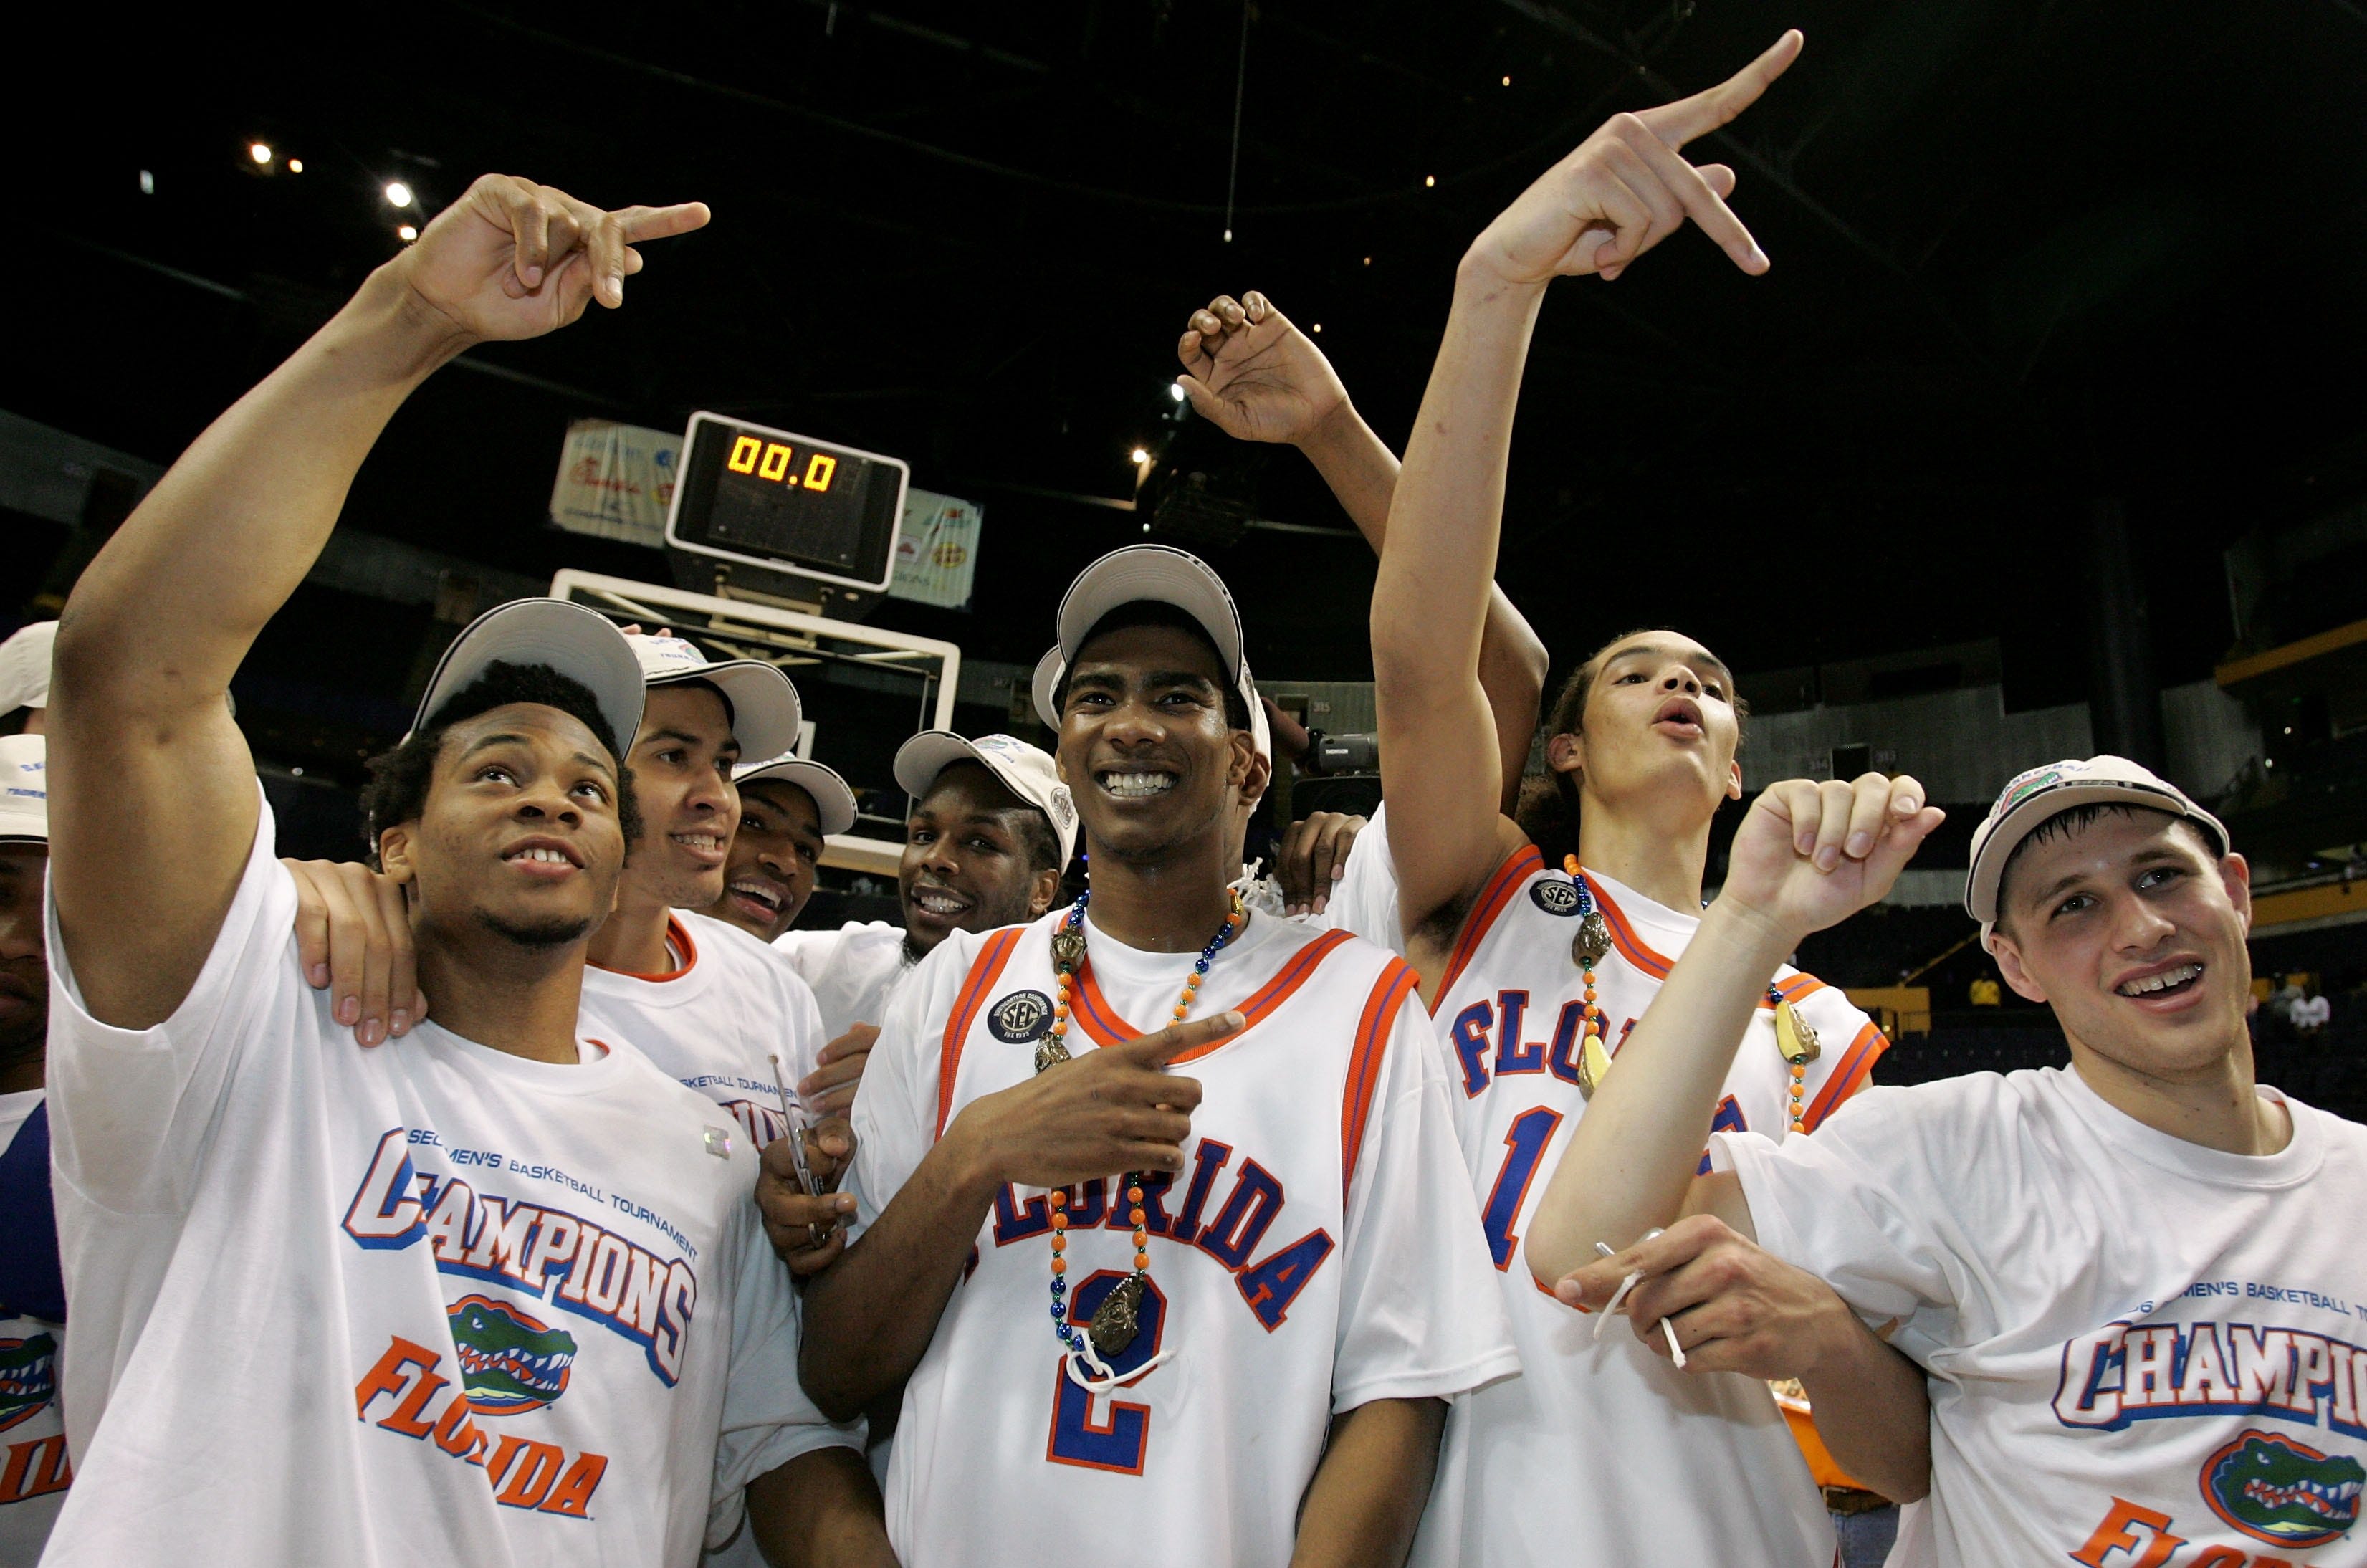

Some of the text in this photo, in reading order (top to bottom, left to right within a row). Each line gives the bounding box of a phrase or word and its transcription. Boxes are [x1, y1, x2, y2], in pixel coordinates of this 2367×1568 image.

[727, 434, 837, 492] 00.0
[1542, 887, 1577, 905] SEC
[1003, 1003, 1038, 1029] SEC
[680, 1075, 734, 1088] SKETBALL
[509, 1159, 604, 1203] BASKETBALL
[611, 1195, 698, 1262] TOURNAMENT
[964, 1137, 1336, 1334] LORIDA
[340, 1127, 697, 1389] CAMPIONS
[2247, 1283, 2351, 1316] BASKETBALL
[1046, 1268, 1167, 1476] 2
